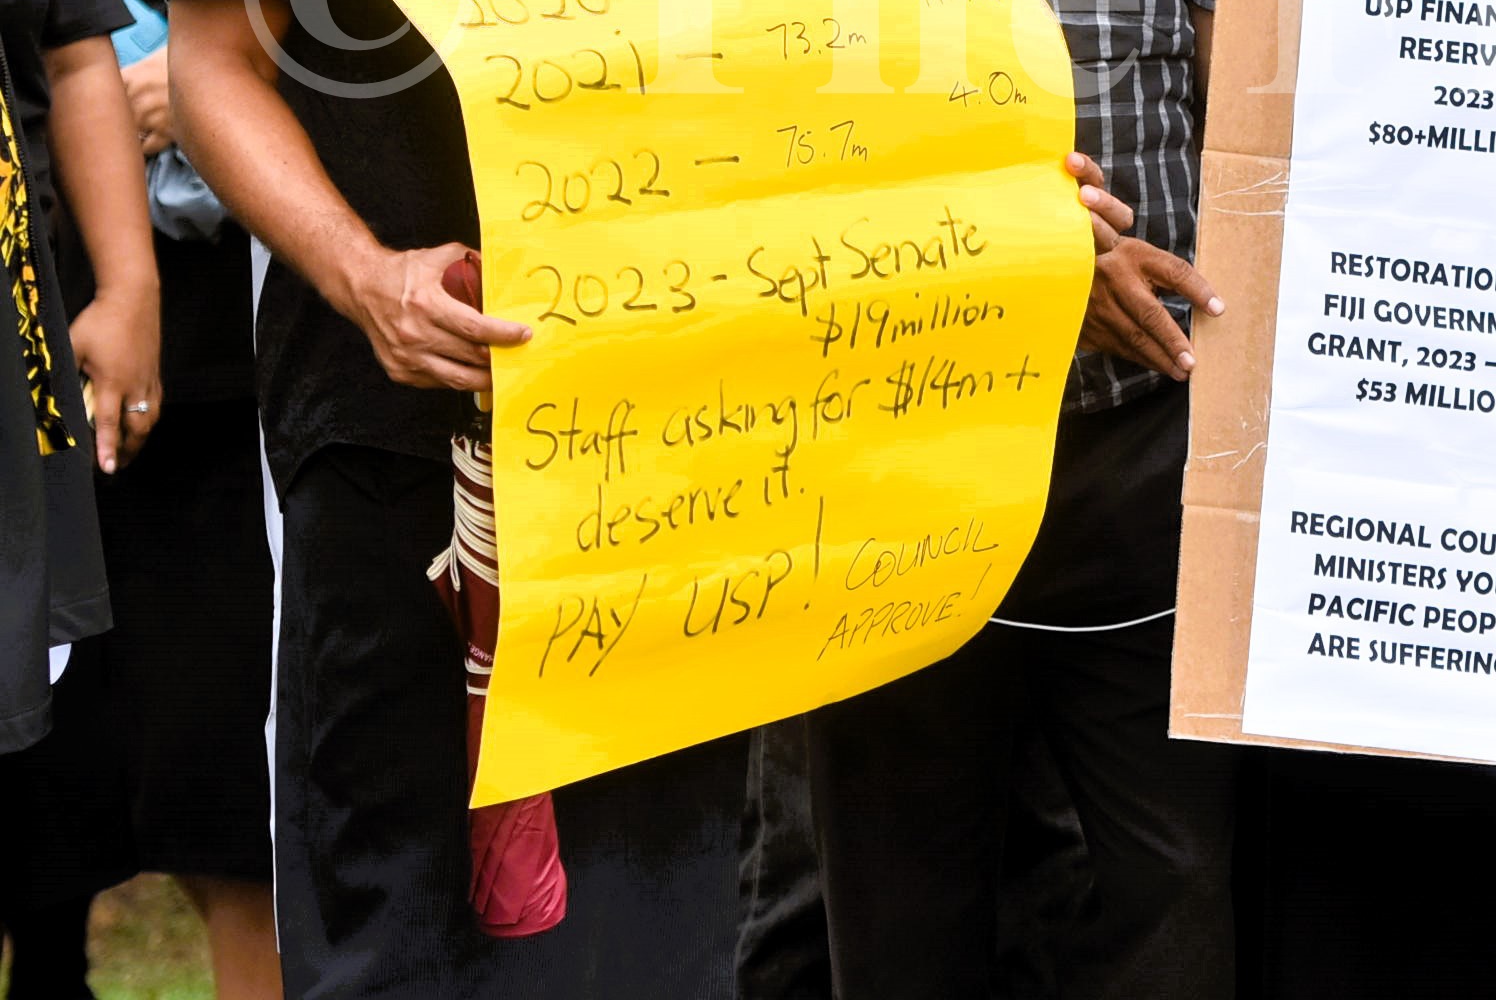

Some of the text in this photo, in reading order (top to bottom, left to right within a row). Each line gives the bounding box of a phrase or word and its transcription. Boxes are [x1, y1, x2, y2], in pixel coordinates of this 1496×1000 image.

[766, 17, 868, 61] 73.2m
[1433, 85, 1495, 110] 2023
[516, 147, 670, 222] 2022
[949, 70, 1027, 107] 4.0m
[525, 259, 696, 326] 2023
[746, 235, 832, 318] Sept
[840, 204, 990, 280] Senate
[1323, 293, 1365, 322] FIJI
[1307, 332, 1409, 367] GRANT,
[1416, 347, 1477, 371] 2023
[1355, 377, 1398, 403] $53
[525, 396, 639, 483] Staff
[661, 378, 798, 452] asking
[810, 369, 871, 440] for
[576, 482, 743, 552] deserve
[1290, 510, 1432, 548] REGIONAL
[845, 517, 1000, 591] COUNCIL
[1313, 553, 1447, 590] MINISTERS
[538, 494, 824, 679] PAY USP!
[816, 562, 993, 661] APPROVE!
[1308, 593, 1416, 627] PACIFIC
[1307, 632, 1361, 660] ARE
